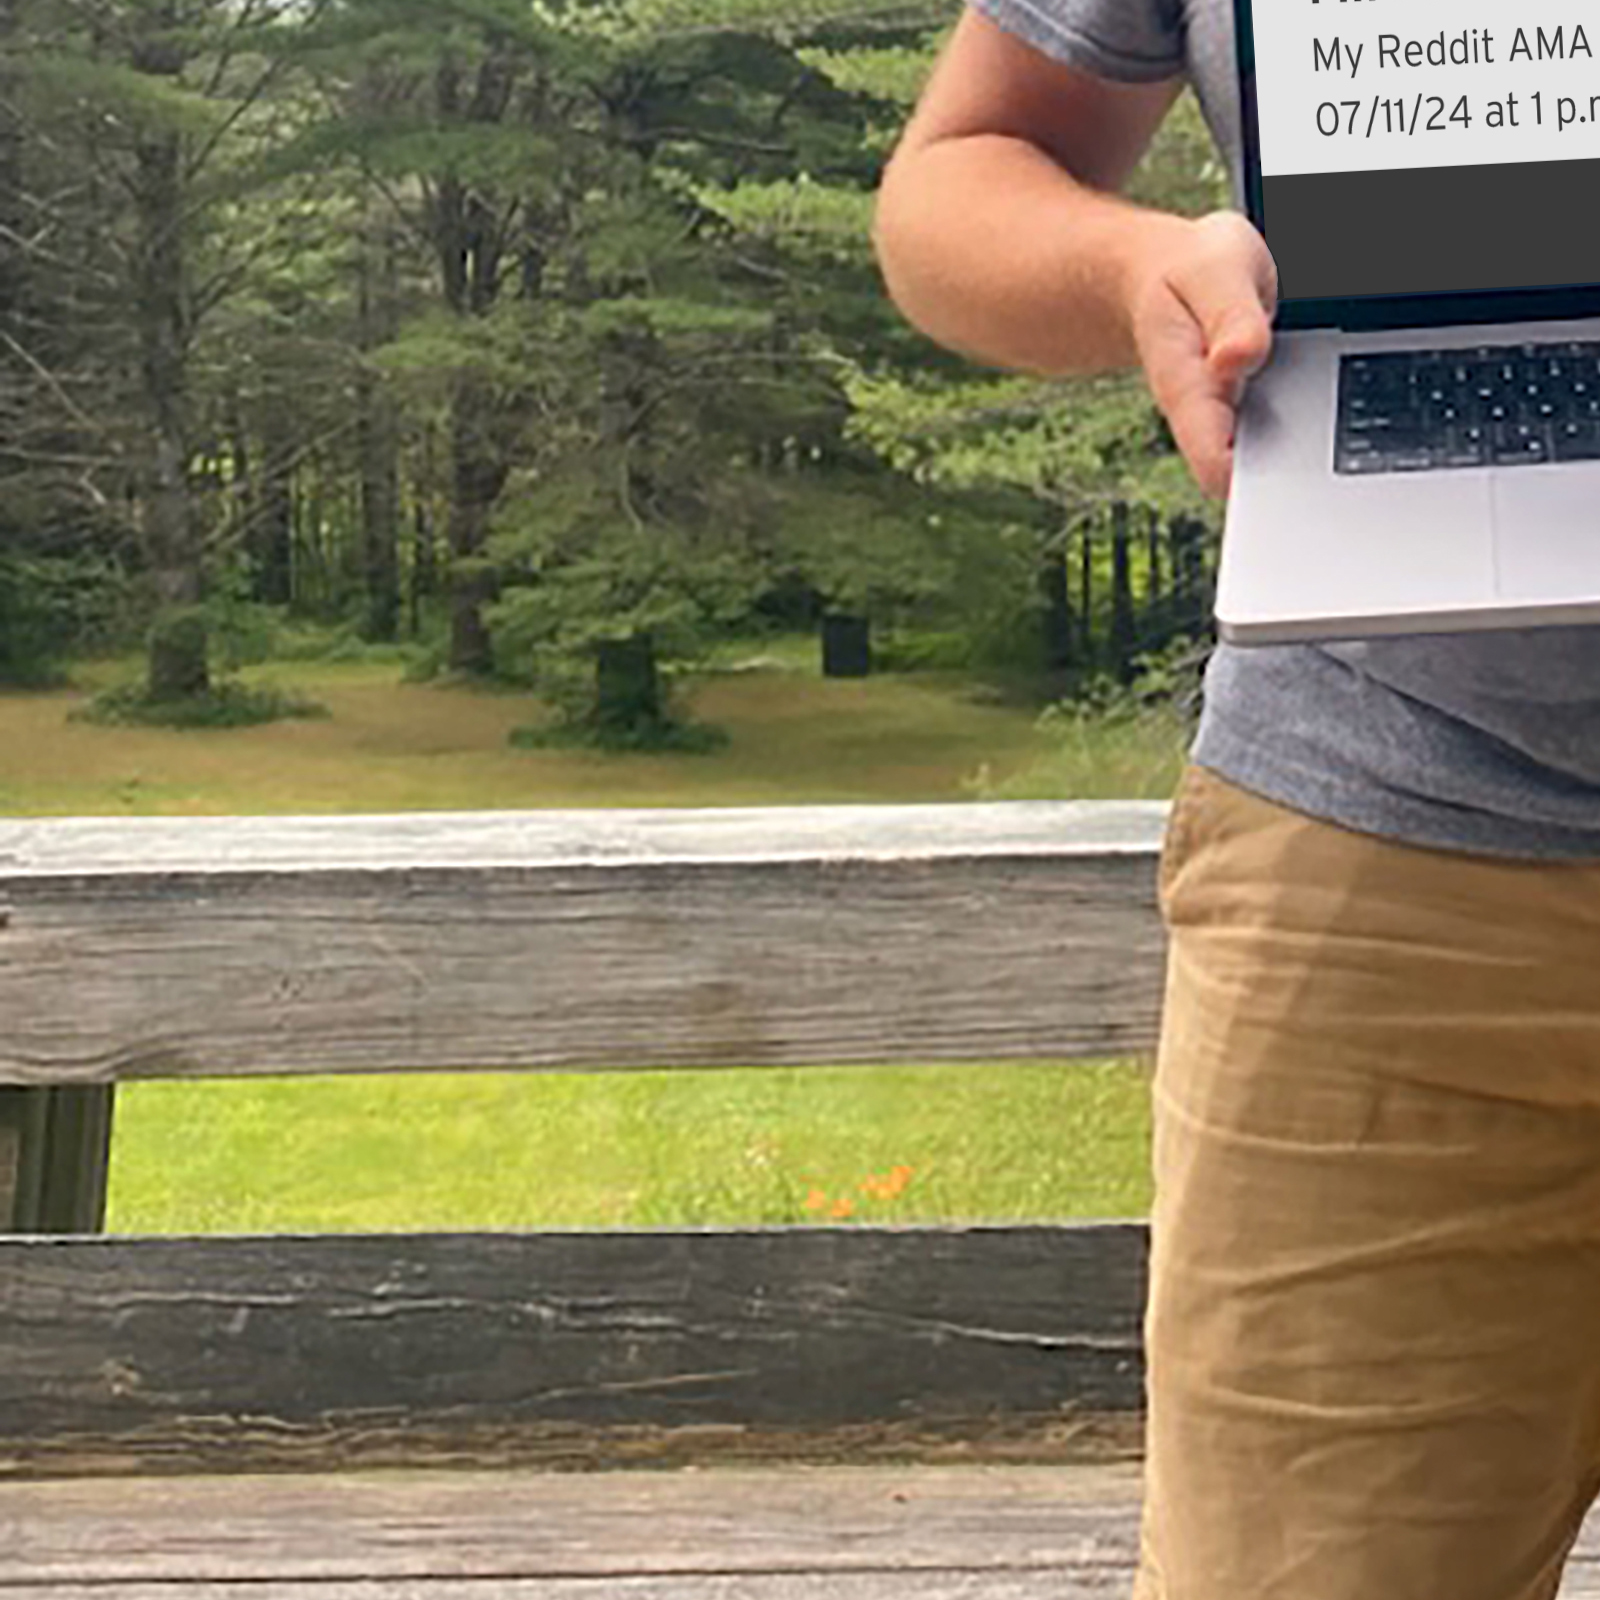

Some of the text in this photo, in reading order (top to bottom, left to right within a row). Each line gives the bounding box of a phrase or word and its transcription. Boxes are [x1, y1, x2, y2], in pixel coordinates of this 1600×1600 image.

[1313, 36, 1364, 79] My
[1378, 27, 1495, 69] Reddit
[1509, 24, 1593, 62] AMA
[1316, 94, 1473, 138] 07/11/24
[1485, 91, 1520, 128] at
[1530, 91, 1542, 125] 1
